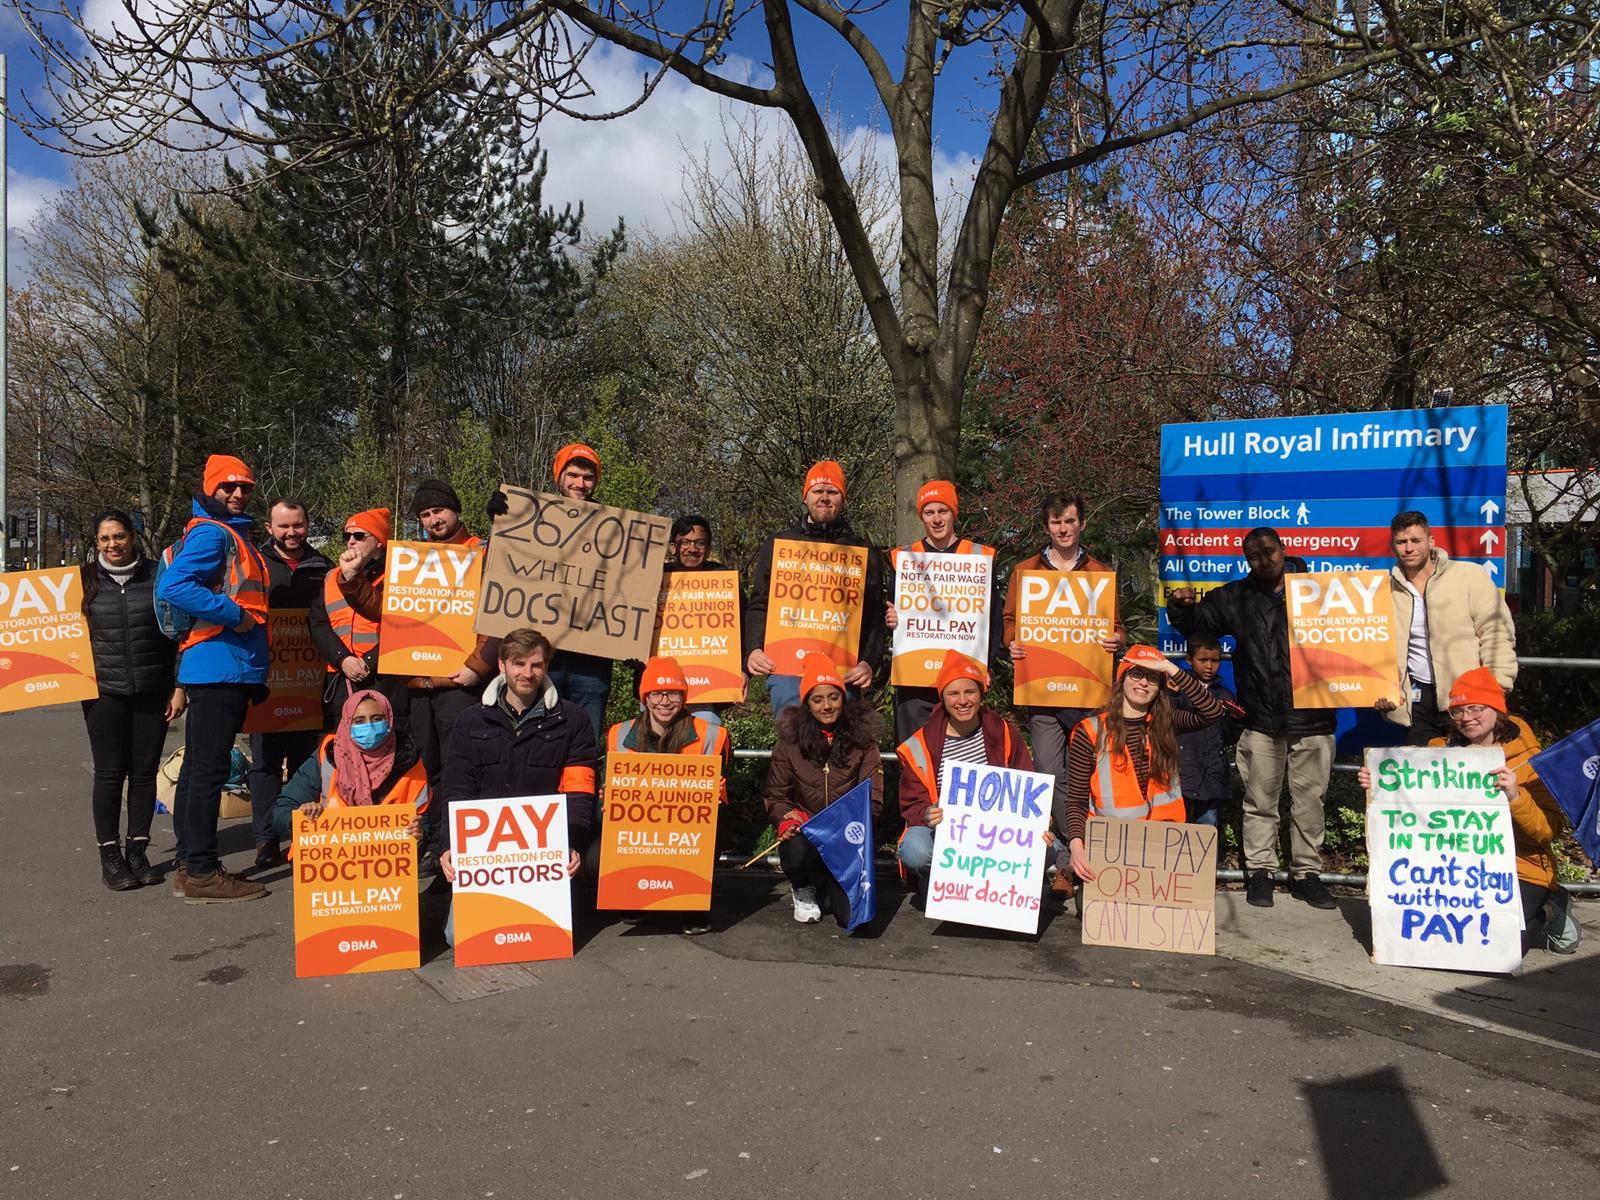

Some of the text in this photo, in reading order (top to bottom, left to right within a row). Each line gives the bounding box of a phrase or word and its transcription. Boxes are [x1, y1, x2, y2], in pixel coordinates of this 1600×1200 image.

[1184, 424, 1477, 459] Hull Royal Infirmary
[1165, 506, 1290, 520] The Tower Block
[495, 489, 666, 569] 26% OFF
[1165, 533, 1229, 546] Accident
[1279, 536, 1360, 550] mergency
[778, 548, 863, 566] £14/HOUR IS
[389, 546, 478, 587] PAY
[508, 554, 608, 590] WHILE
[776, 560, 862, 576] NOT A FAIR WAGE
[902, 560, 987, 574] £14/HOUR IS
[1165, 560, 1184, 572] All
[1189, 560, 1232, 573] Other
[722, 578, 734, 589] IS
[776, 570, 861, 588] FOR A JUNIOR
[901, 572, 986, 584] NOT A FAIR WAGE
[388, 586, 476, 599] RESTORATION FOR
[674, 592, 680, 600] A
[682, 592, 705, 600] FAIR
[706, 591, 734, 600] WAGE
[774, 582, 860, 606] DOCTOR
[900, 582, 986, 596] FOR A JUNIOR
[1020, 576, 1110, 616] PAY
[1290, 576, 1384, 616] PAY
[387, 596, 474, 616] DOCTORS
[483, 581, 650, 641] DOCS LAST
[658, 600, 735, 612] OR A JUNIOR
[900, 594, 986, 614] DOCTOR
[0, 612, 81, 630] STORATION FOR
[780, 606, 850, 624] FULL PAY
[1020, 615, 1110, 627] RESTORATION FOR
[1293, 616, 1388, 627] RESTORATION FOR
[281, 628, 302, 636] FAIR
[780, 620, 830, 630] RESTORATION
[906, 618, 977, 633] FULL PAY
[0, 622, 84, 646] OCTORS
[659, 635, 728, 650] FULL PAY
[906, 632, 957, 640] RESTORATION
[1020, 626, 1109, 644] DOCTORS
[1294, 626, 1390, 644] DOCTORS
[422, 652, 442, 662] BMA
[711, 648, 728, 656] NOW
[296, 668, 320, 681] PAY
[689, 677, 710, 686] BMA
[36, 680, 60, 692] BMA
[1056, 682, 1078, 692] BMA
[1339, 682, 1362, 692] BMA
[284, 708, 303, 716] BMA
[613, 762, 715, 778] £14/HOUR IS
[1378, 758, 1500, 798] Striking
[612, 777, 714, 790] NOT A FAIR WAGE
[948, 766, 1050, 818] HONK
[611, 789, 714, 804] FOR A JUNIOR
[610, 803, 712, 824] DOCTOR
[1381, 809, 1500, 830] TO STAY
[300, 813, 410, 833] £14/HOUR IS
[455, 802, 560, 854] PAY
[300, 830, 410, 846] NOT A FAIR WAGE
[618, 831, 702, 847] FULL PAY
[950, 814, 1034, 851] if you
[300, 842, 411, 862] FOR A JUNIOR
[616, 847, 700, 856] RESTORATION NOW
[1088, 821, 1216, 874] FULL PAY
[1389, 832, 1506, 855] IN THE UK
[458, 850, 563, 866] RESTORATION FOR
[939, 847, 1032, 879] Support
[300, 856, 412, 884] DOCTOR
[458, 863, 564, 888] DOCTORS
[650, 880, 674, 890] BMA
[1098, 866, 1194, 904] OR WE
[1388, 854, 1514, 904] Can't stay
[311, 886, 402, 908] FULL PAY
[932, 880, 1040, 910] your doctors
[1388, 887, 1486, 910] without
[312, 903, 402, 918] RESTORATION NOW
[1150, 906, 1212, 951] STAY
[1401, 909, 1490, 946] PAY!
[351, 940, 378, 951] BMA
[506, 932, 532, 943] BMA
